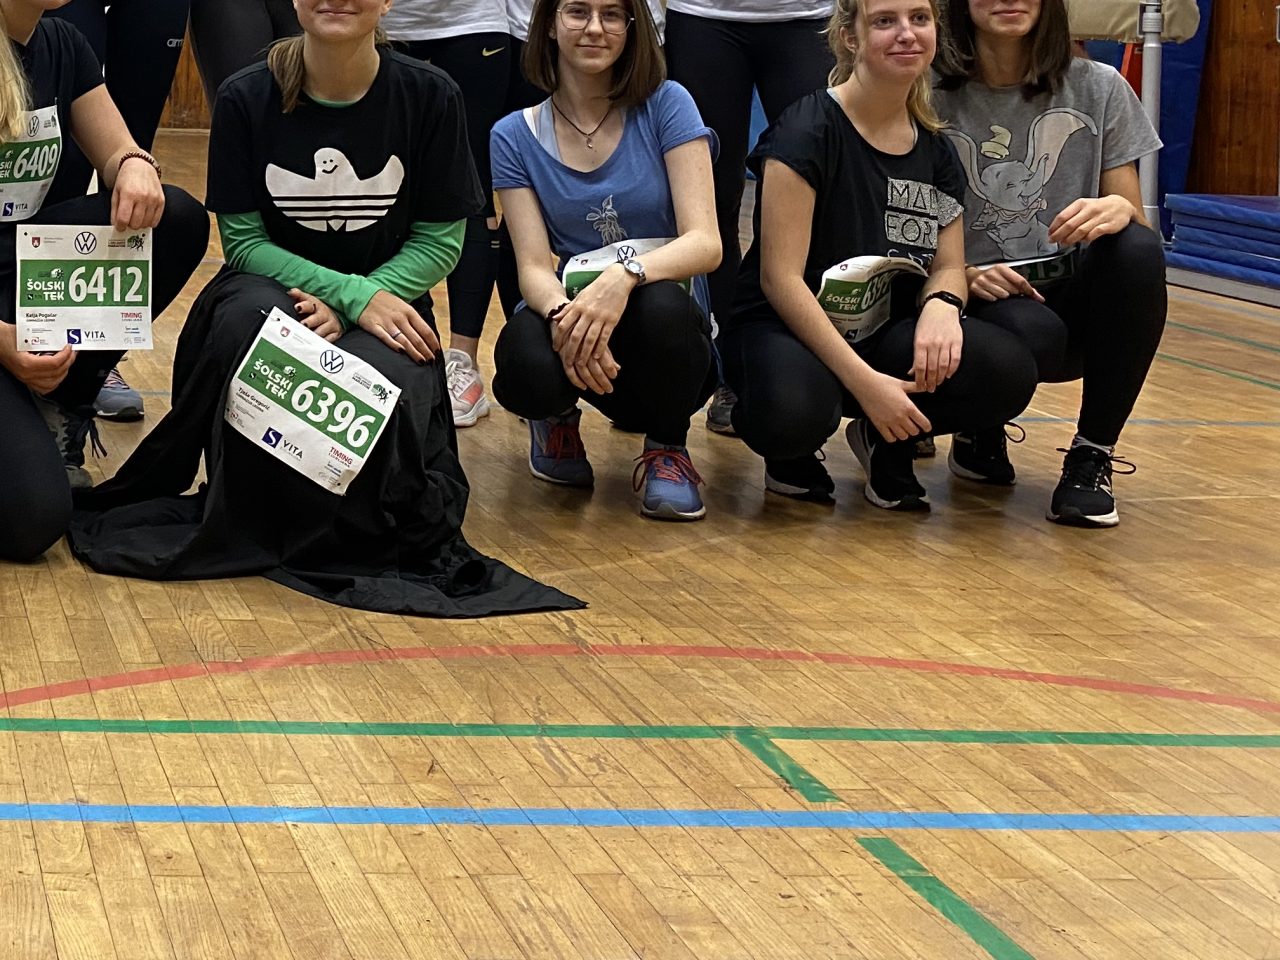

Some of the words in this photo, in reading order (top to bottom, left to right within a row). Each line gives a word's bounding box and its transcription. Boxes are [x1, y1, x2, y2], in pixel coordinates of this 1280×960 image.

[14, 143, 58, 179] 6409
[887, 214, 933, 246] FOR
[27, 279, 64, 291] ŠOLSKI
[69, 266, 143, 303] 6412
[43, 292, 64, 300] TEK
[825, 293, 861, 303] ŠOLSKI
[839, 303, 858, 311] TEK
[253, 359, 293, 391] ŠOLSKI
[265, 379, 289, 400] TEK
[291, 379, 376, 448] 6396
[283, 440, 303, 459] VITA
[330, 446, 353, 465] TIMING
